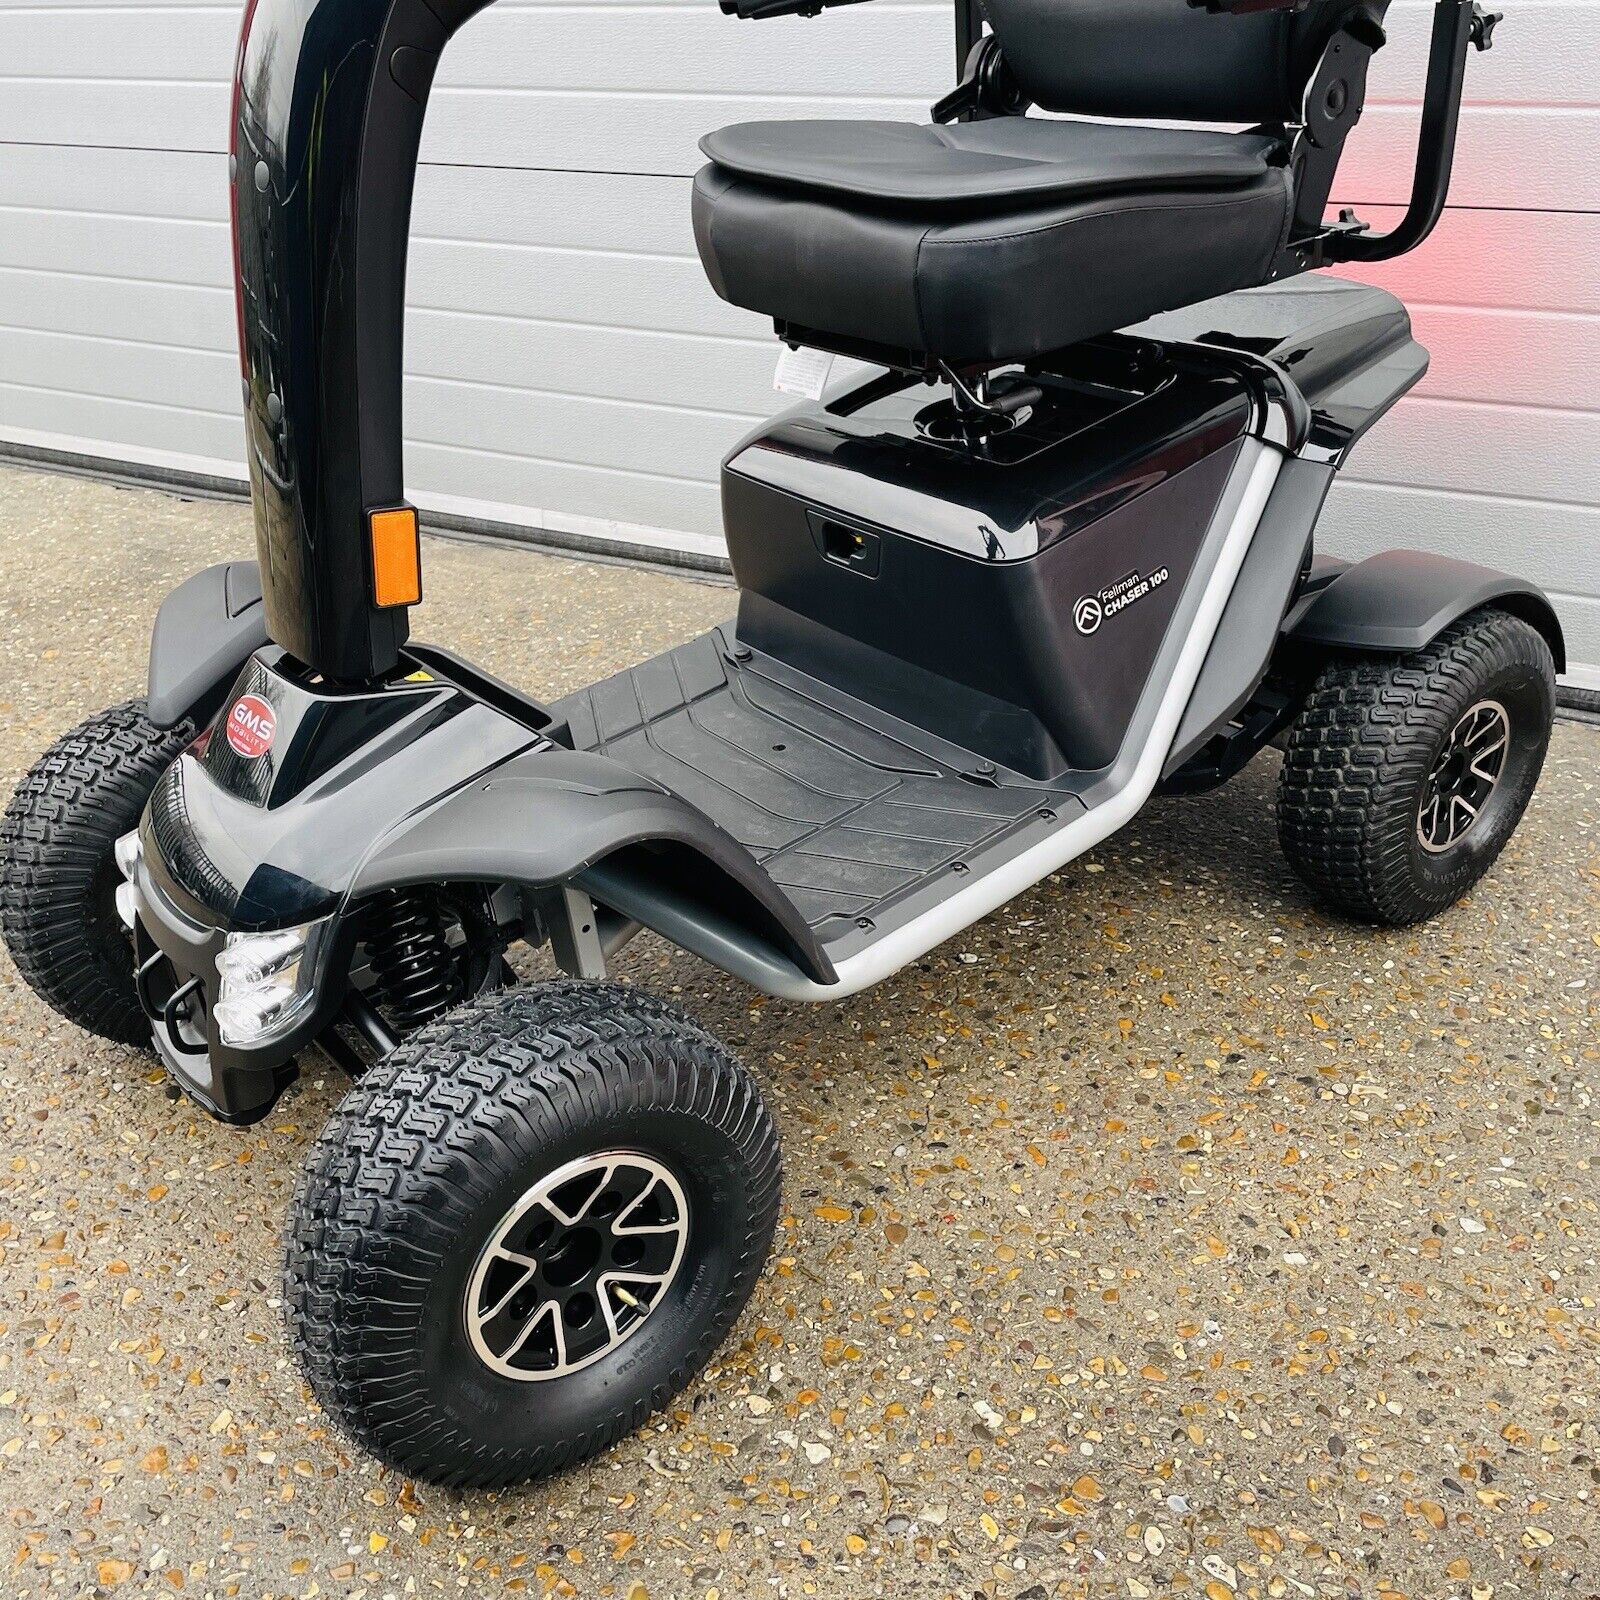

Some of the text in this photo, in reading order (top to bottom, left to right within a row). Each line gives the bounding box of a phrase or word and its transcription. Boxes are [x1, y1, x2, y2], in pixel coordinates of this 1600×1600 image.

[1102, 574, 1140, 603] Fellman
[1104, 568, 1169, 617] CHASER 100
[229, 721, 265, 750] MOBILITY
[233, 703, 274, 741] GMS
